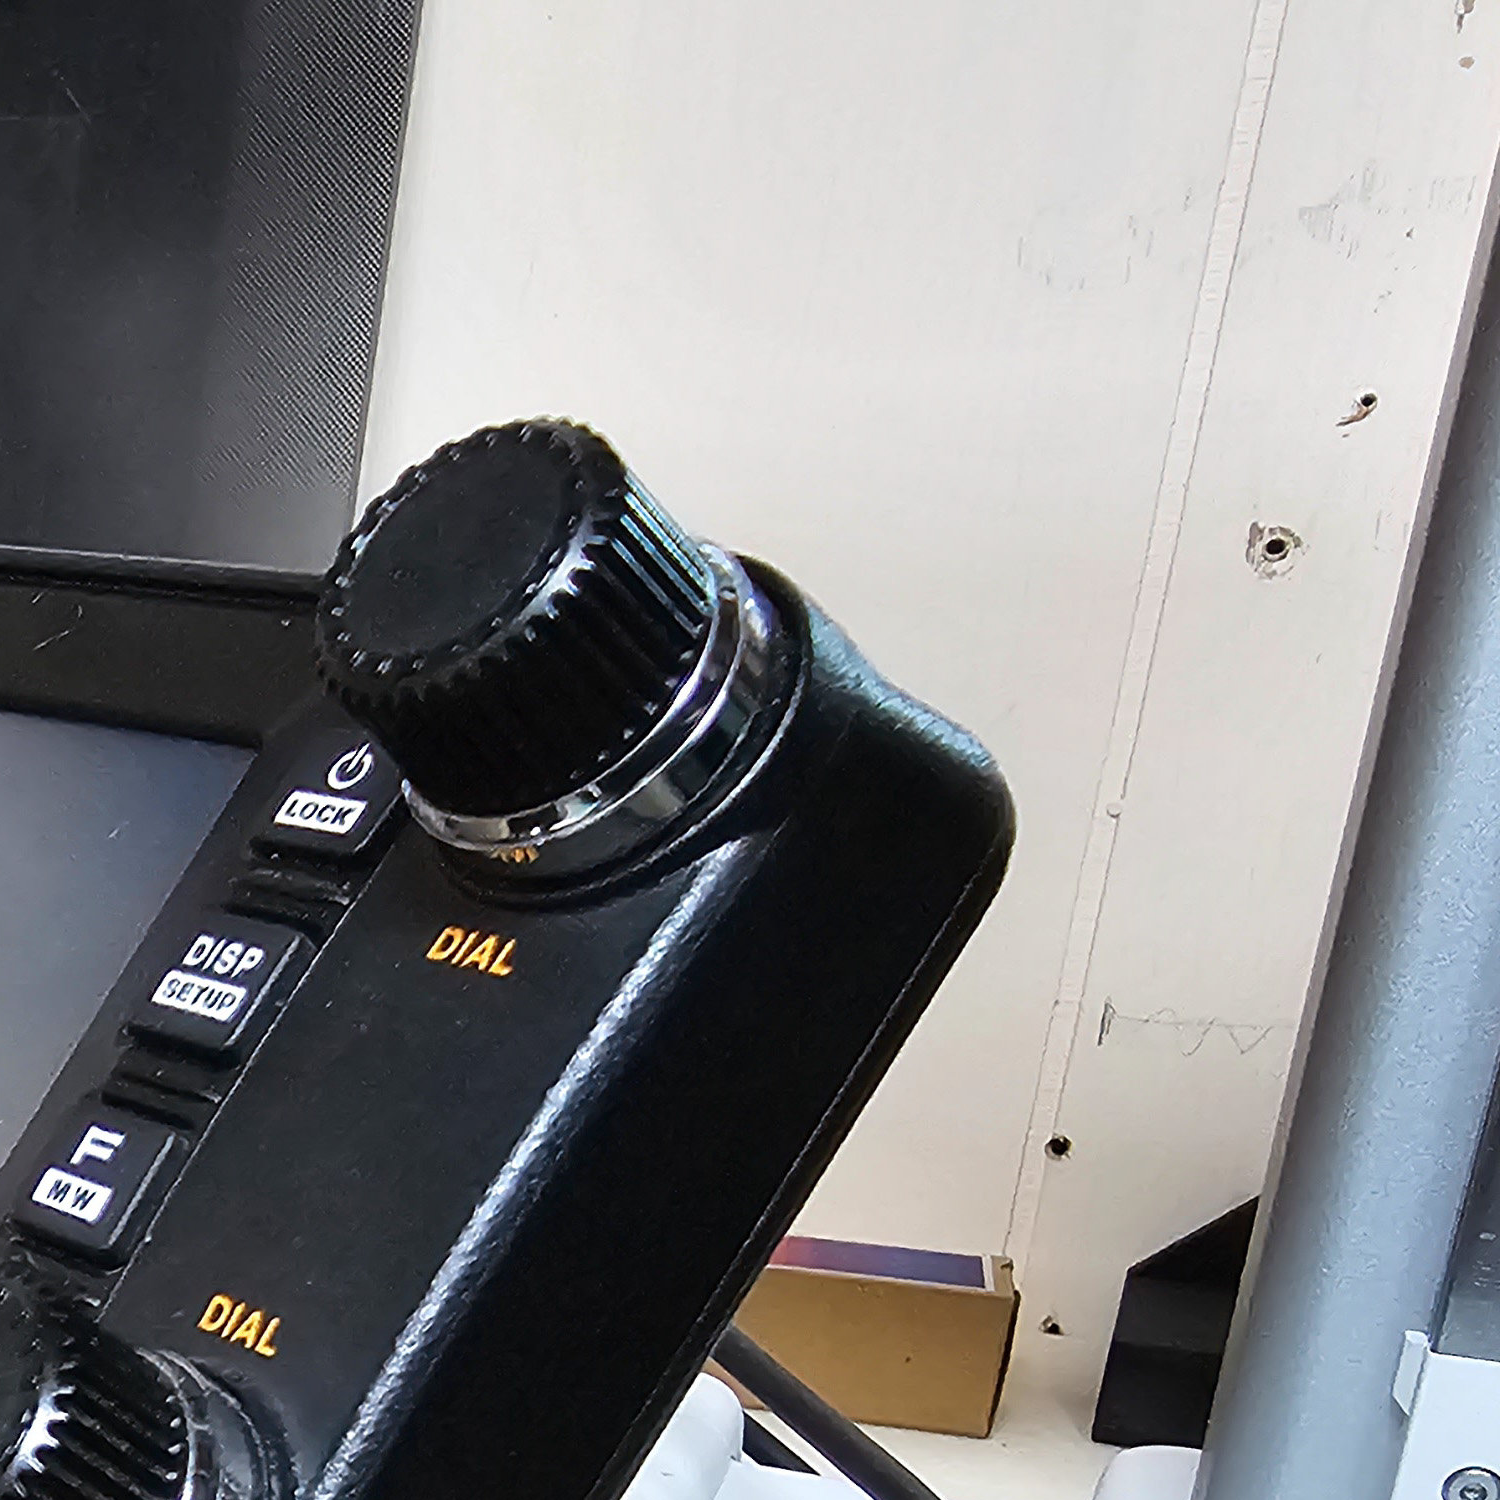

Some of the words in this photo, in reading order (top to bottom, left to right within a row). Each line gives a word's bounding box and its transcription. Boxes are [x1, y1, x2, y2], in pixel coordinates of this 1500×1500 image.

[284, 798, 357, 826] LOCK
[181, 934, 264, 978] DISP
[426, 925, 516, 976] DIAL
[162, 978, 237, 1011] SETUP
[69, 1125, 126, 1165] F
[197, 1295, 280, 1358] DIAL
